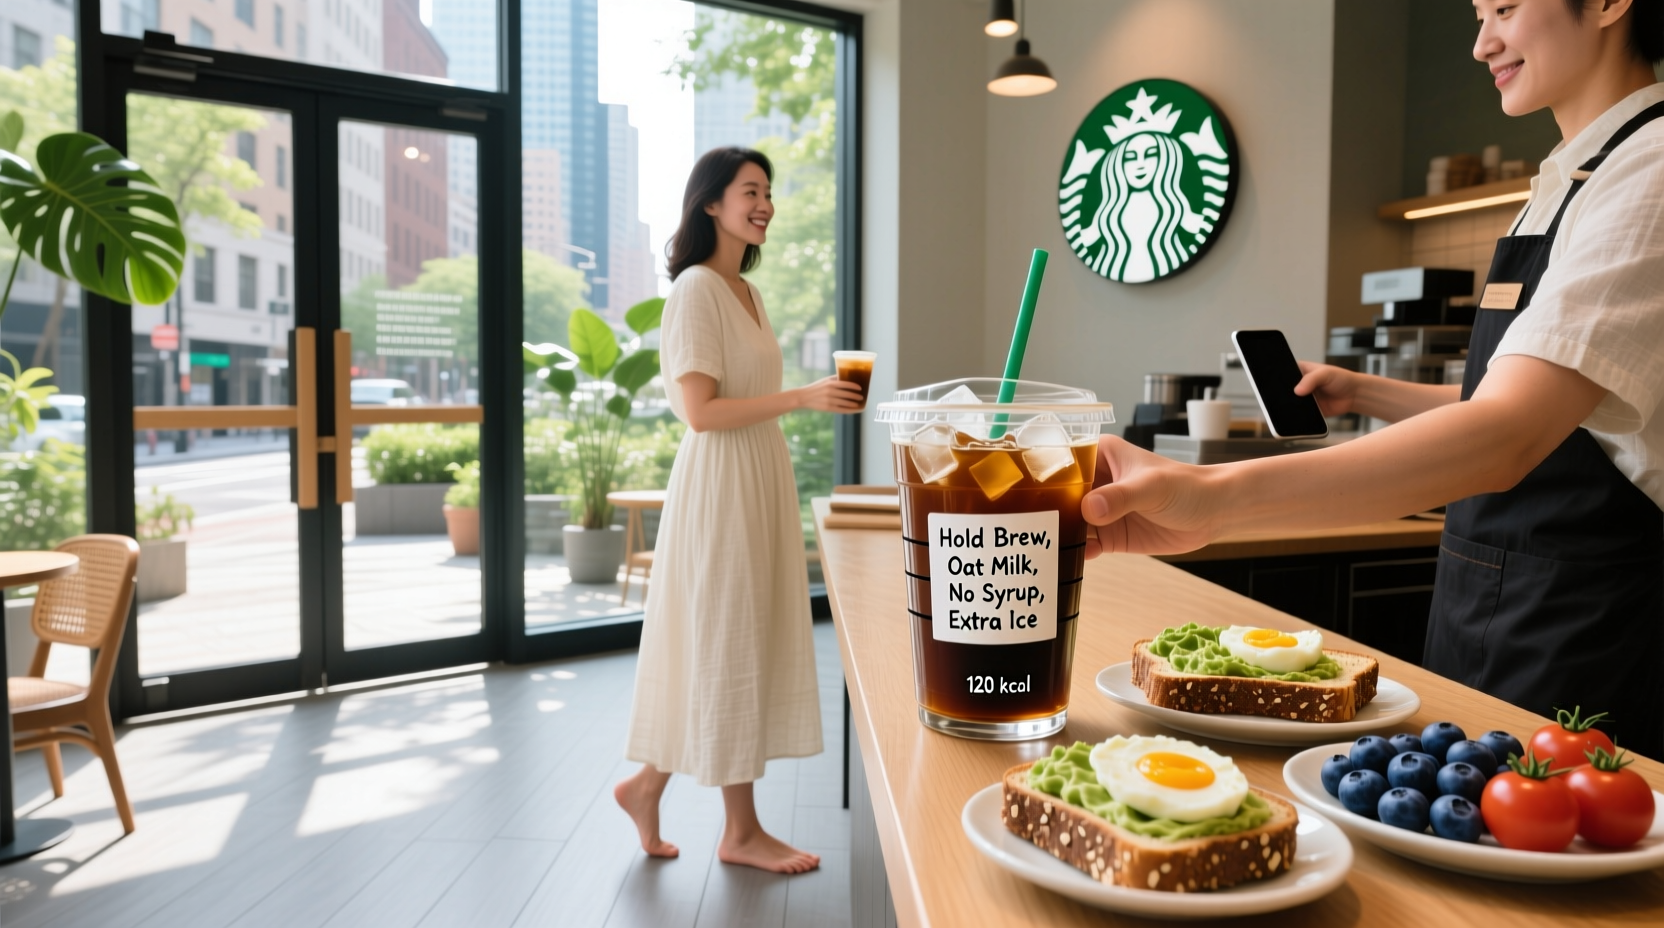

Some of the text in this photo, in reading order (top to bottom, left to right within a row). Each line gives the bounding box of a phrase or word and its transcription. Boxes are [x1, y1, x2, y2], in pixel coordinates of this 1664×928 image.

[940, 526, 1051, 550] Hold Brew,
[947, 553, 1038, 577] Oat Milk,
[949, 582, 1045, 610] No Syrup,
[949, 609, 1038, 631] Extra Ice
[966, 674, 1031, 694] 120 kcal
